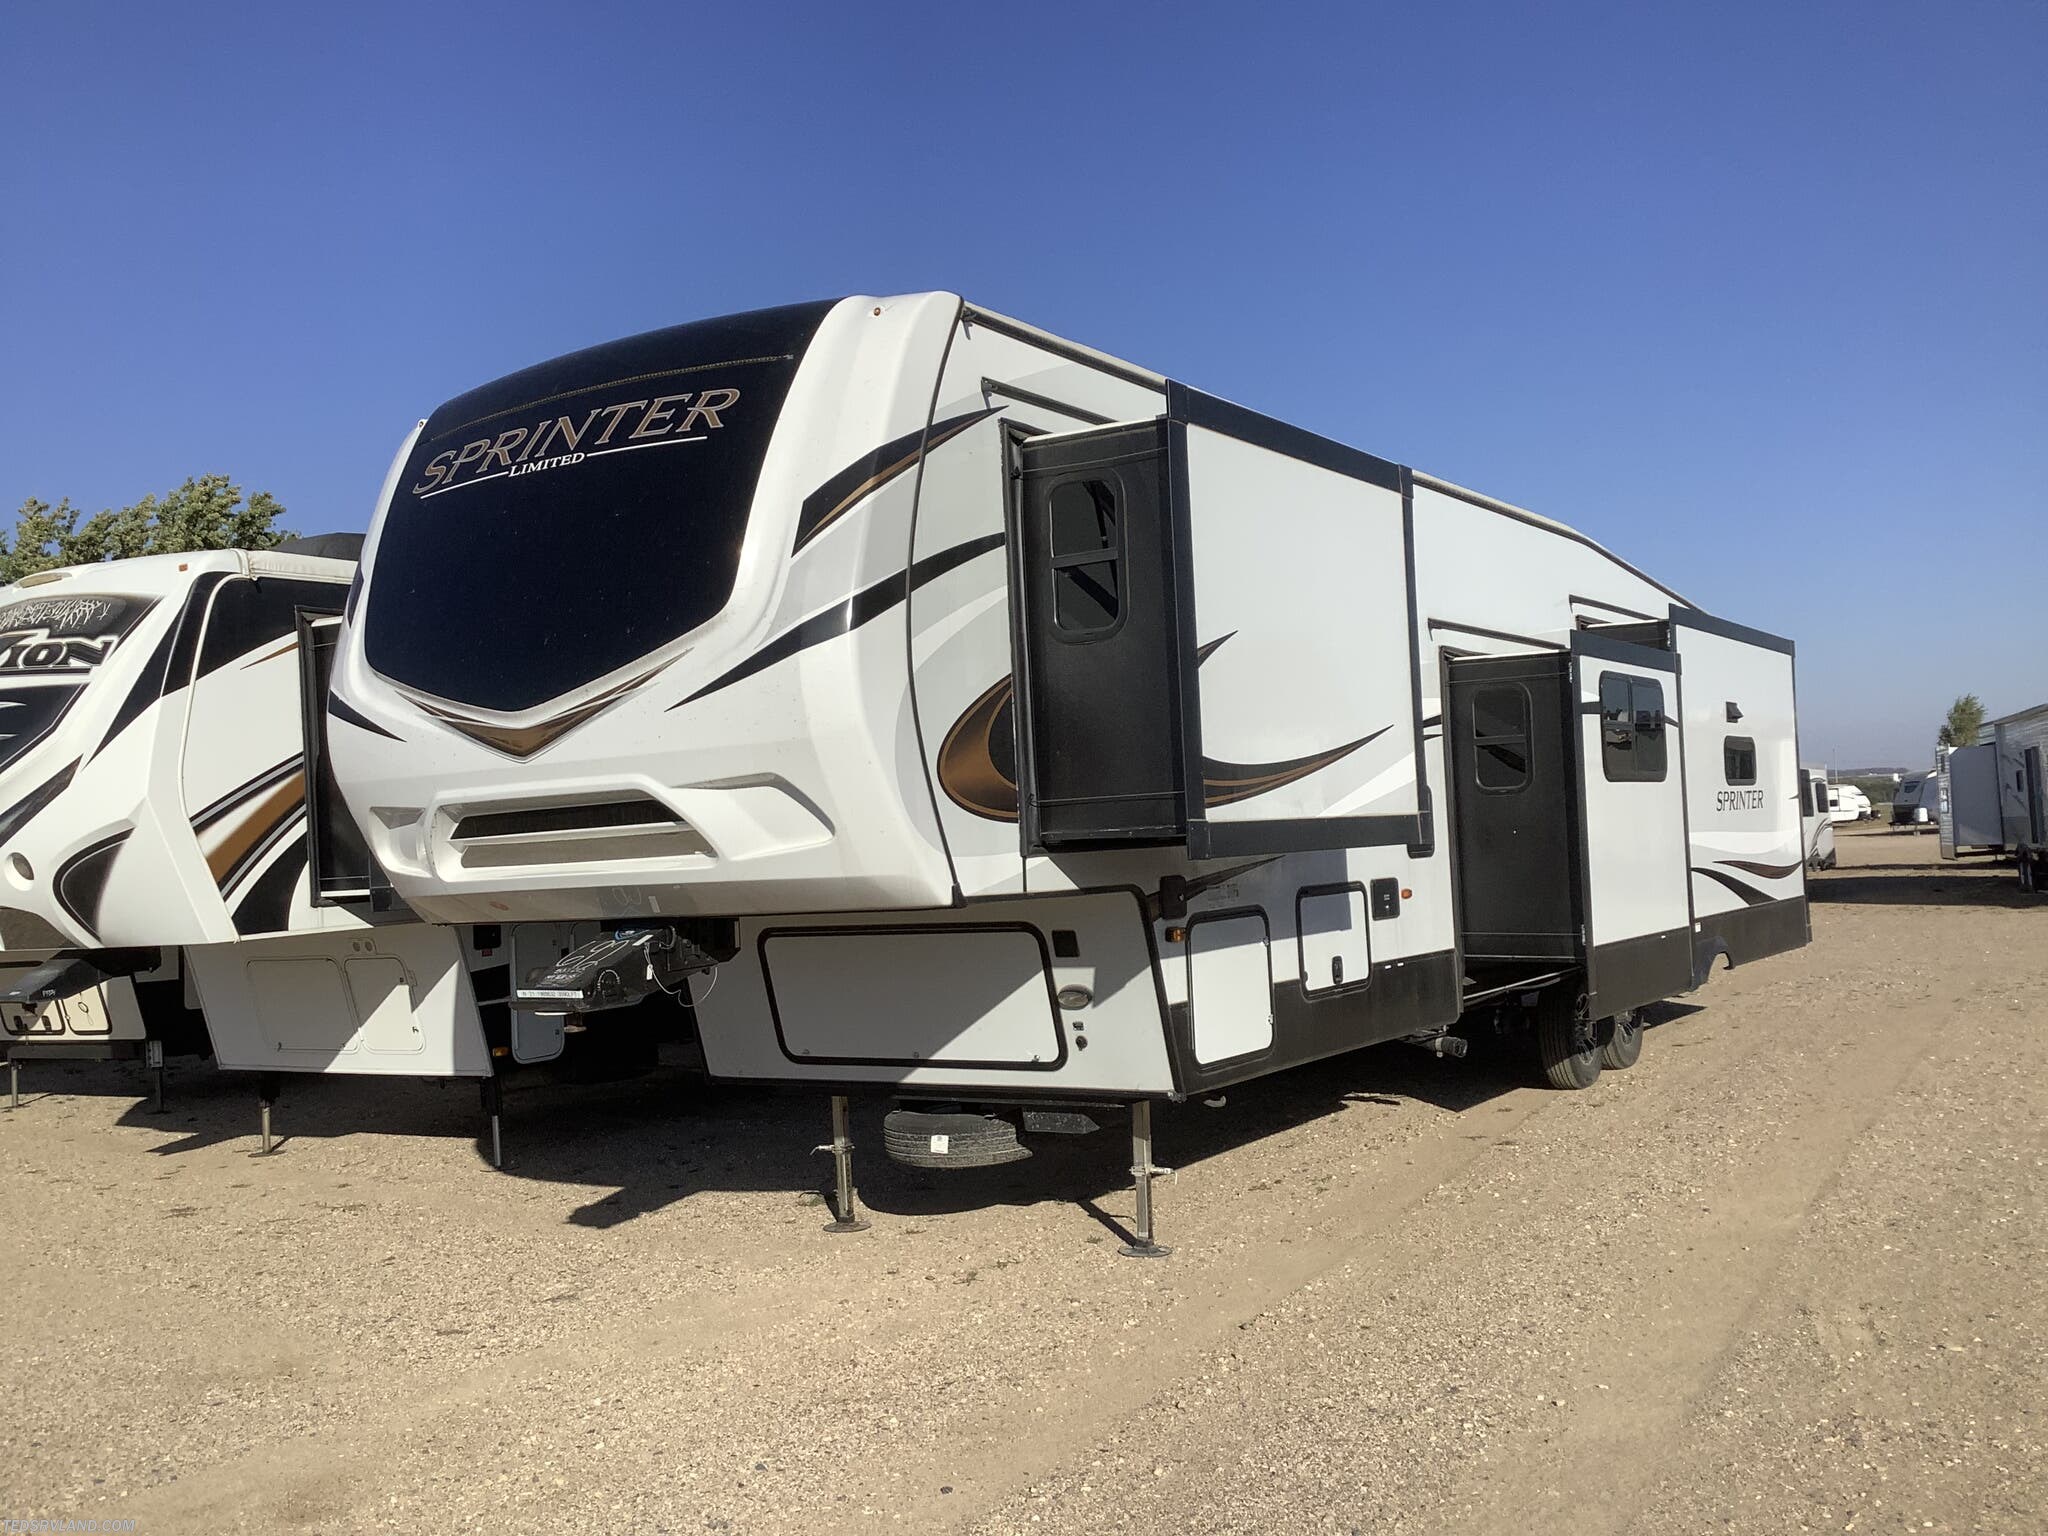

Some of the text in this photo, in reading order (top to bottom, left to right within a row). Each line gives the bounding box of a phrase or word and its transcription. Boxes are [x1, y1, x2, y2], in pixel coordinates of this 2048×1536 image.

[412, 388, 741, 495] SPRINTER
[508, 452, 586, 477] LIMITED
[1716, 790, 1764, 812] SPRINTER
